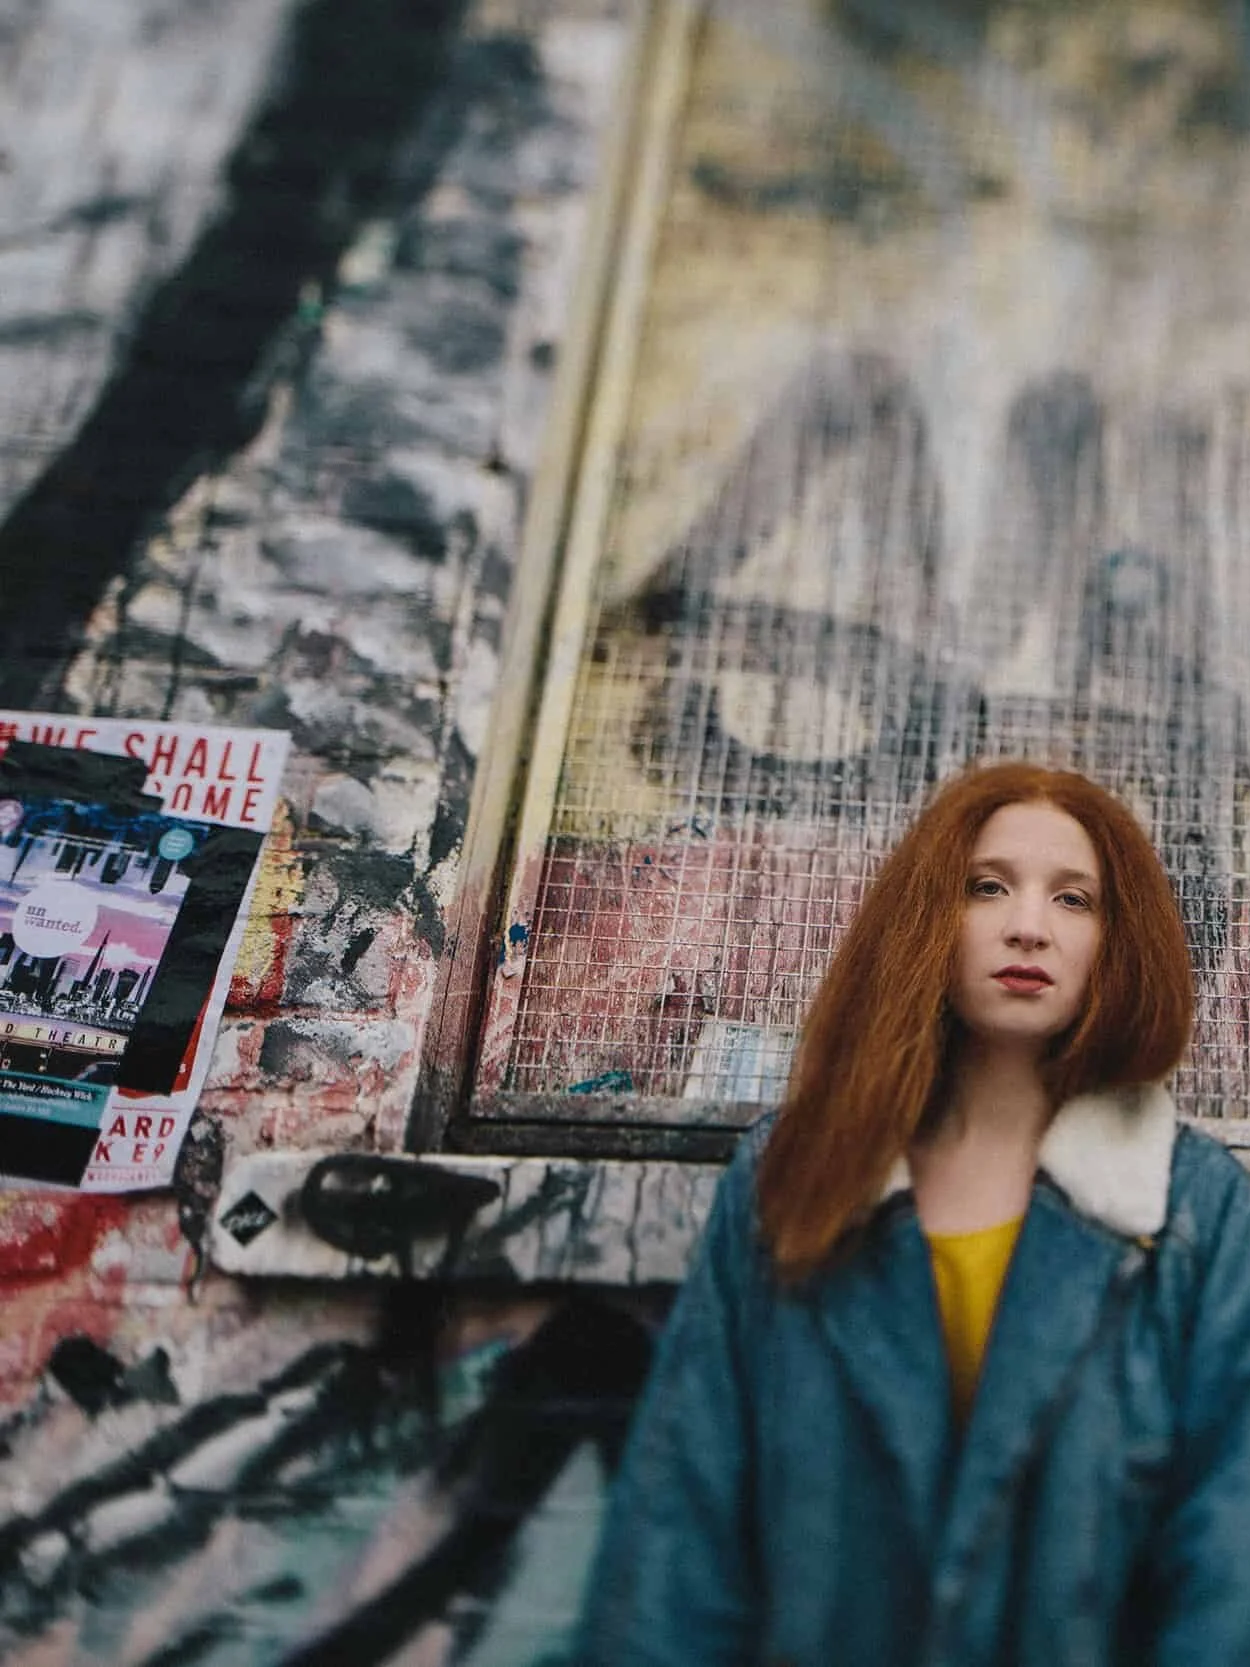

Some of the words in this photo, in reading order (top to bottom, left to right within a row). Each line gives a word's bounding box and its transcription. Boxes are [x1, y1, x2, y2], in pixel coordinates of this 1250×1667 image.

[123, 732, 265, 783] SHALL
[155, 781, 263, 823] OME
[26, 905, 47, 916] un
[24, 914, 83, 934] wanted.
[35, 1027, 129, 1050] THEATR
